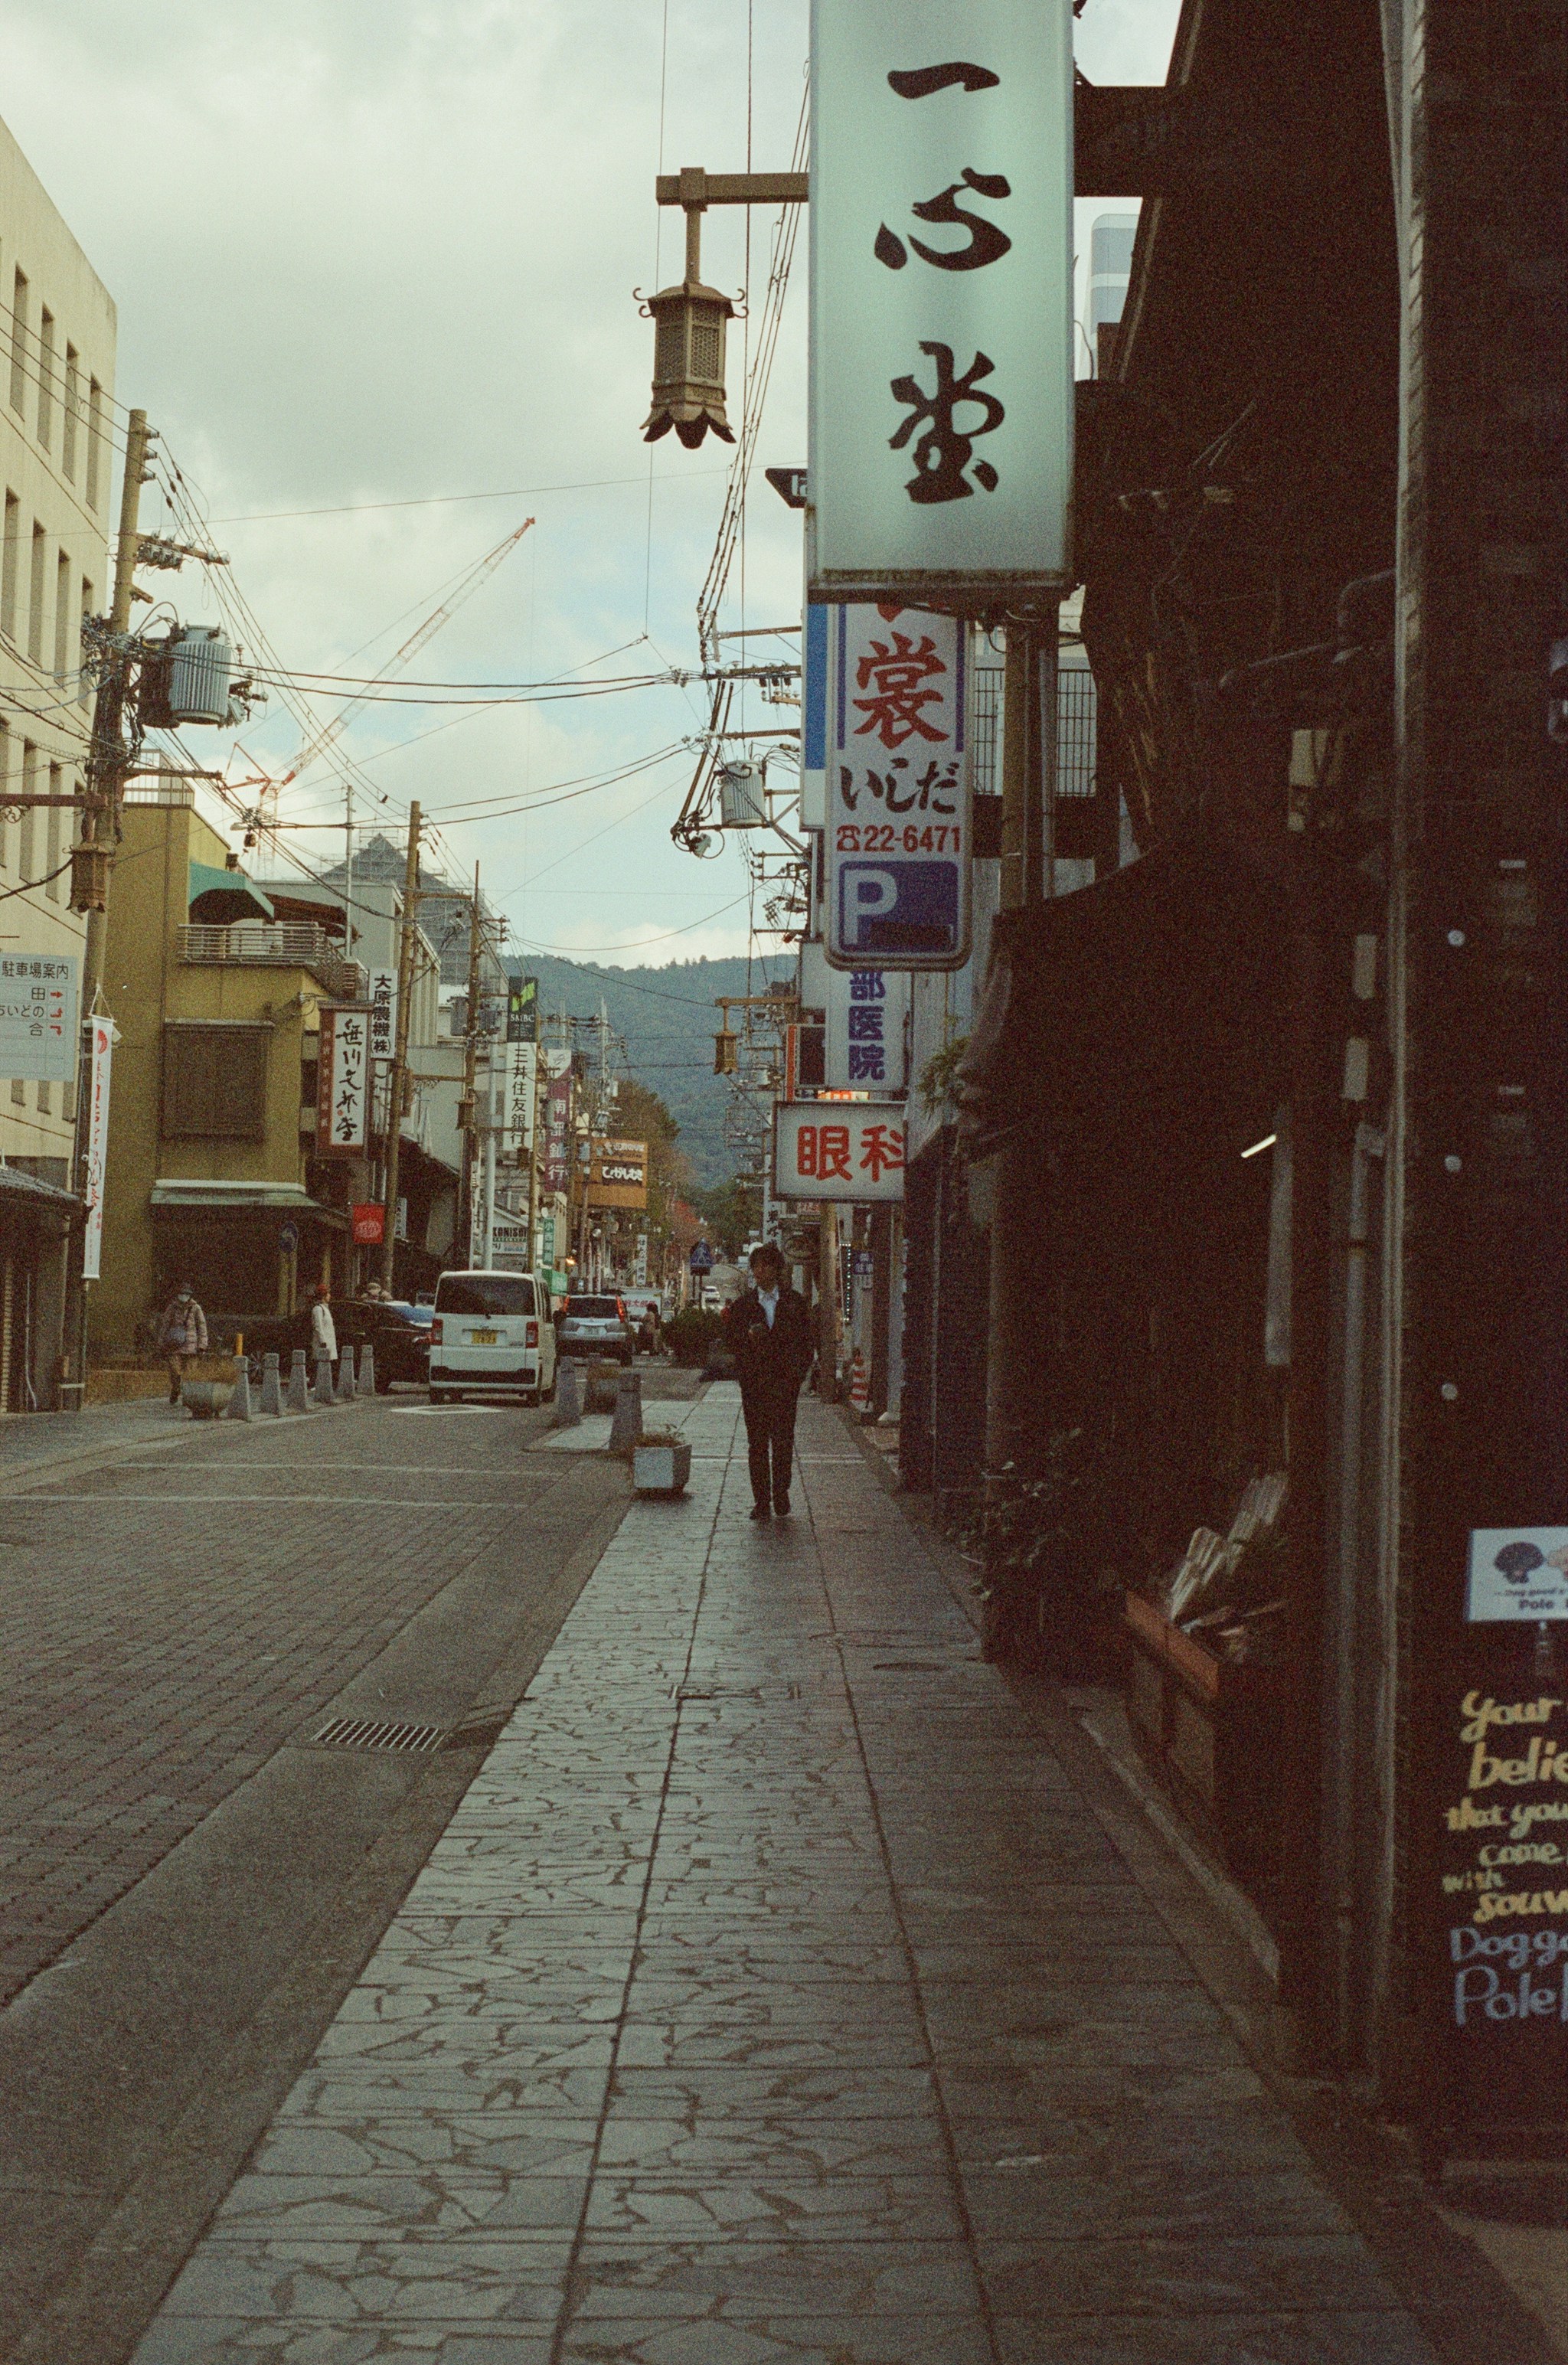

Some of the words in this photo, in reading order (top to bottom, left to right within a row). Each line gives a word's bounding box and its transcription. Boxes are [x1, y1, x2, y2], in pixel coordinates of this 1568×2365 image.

[874, 61, 1011, 504] 一心堂
[839, 759, 960, 815] いしだ
[844, 868, 898, 945] P
[2, 960, 69, 980] 駐車場案内
[510, 1014, 535, 1023] SMBC
[510, 1048, 528, 1146] 三井住友銀行
[797, 1125, 904, 1183] 眼科
[1441, 1868, 1504, 1893] with
